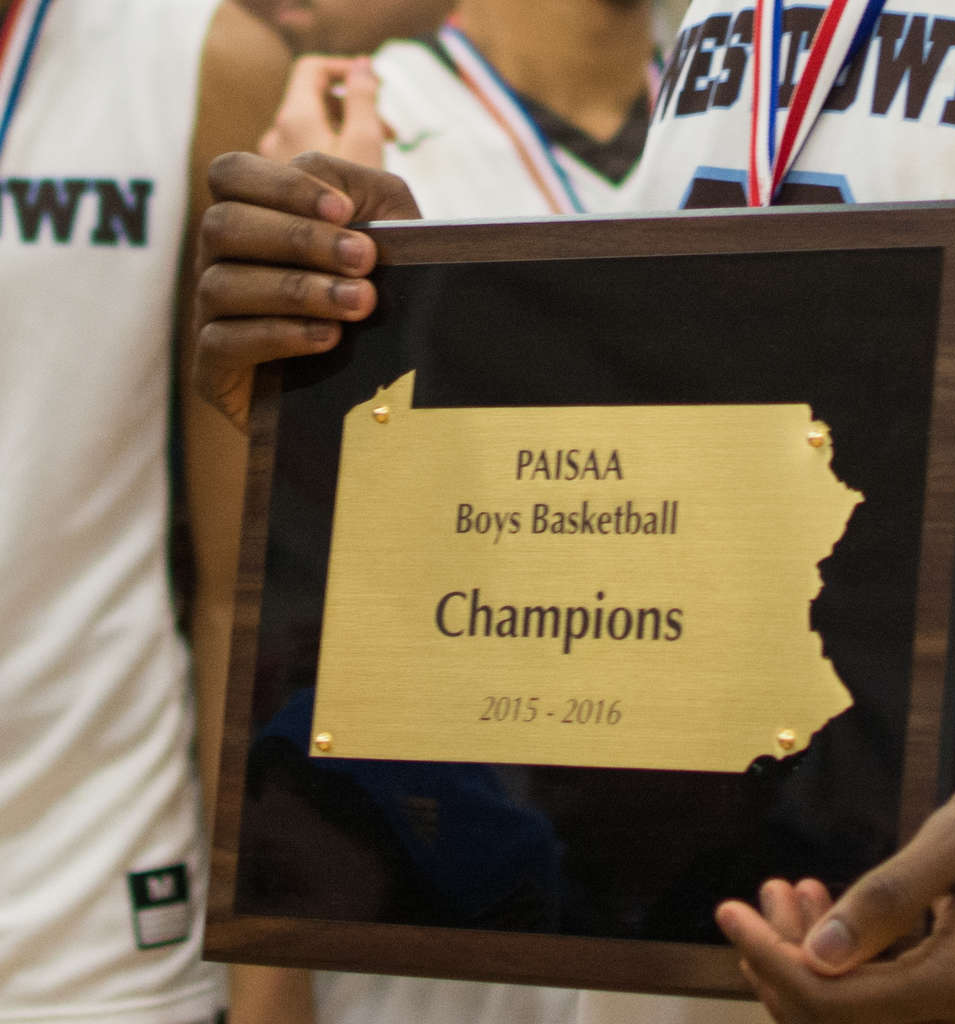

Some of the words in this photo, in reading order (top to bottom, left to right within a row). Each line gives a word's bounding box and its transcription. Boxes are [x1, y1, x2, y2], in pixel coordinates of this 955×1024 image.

[0, 178, 153, 245] WN
[515, 448, 624, 481] PAISAA
[455, 502, 521, 544] Boys
[530, 500, 679, 535] Basketball
[434, 587, 684, 655] Champions
[477, 695, 540, 722] 2015
[560, 697, 623, 725] 2016
